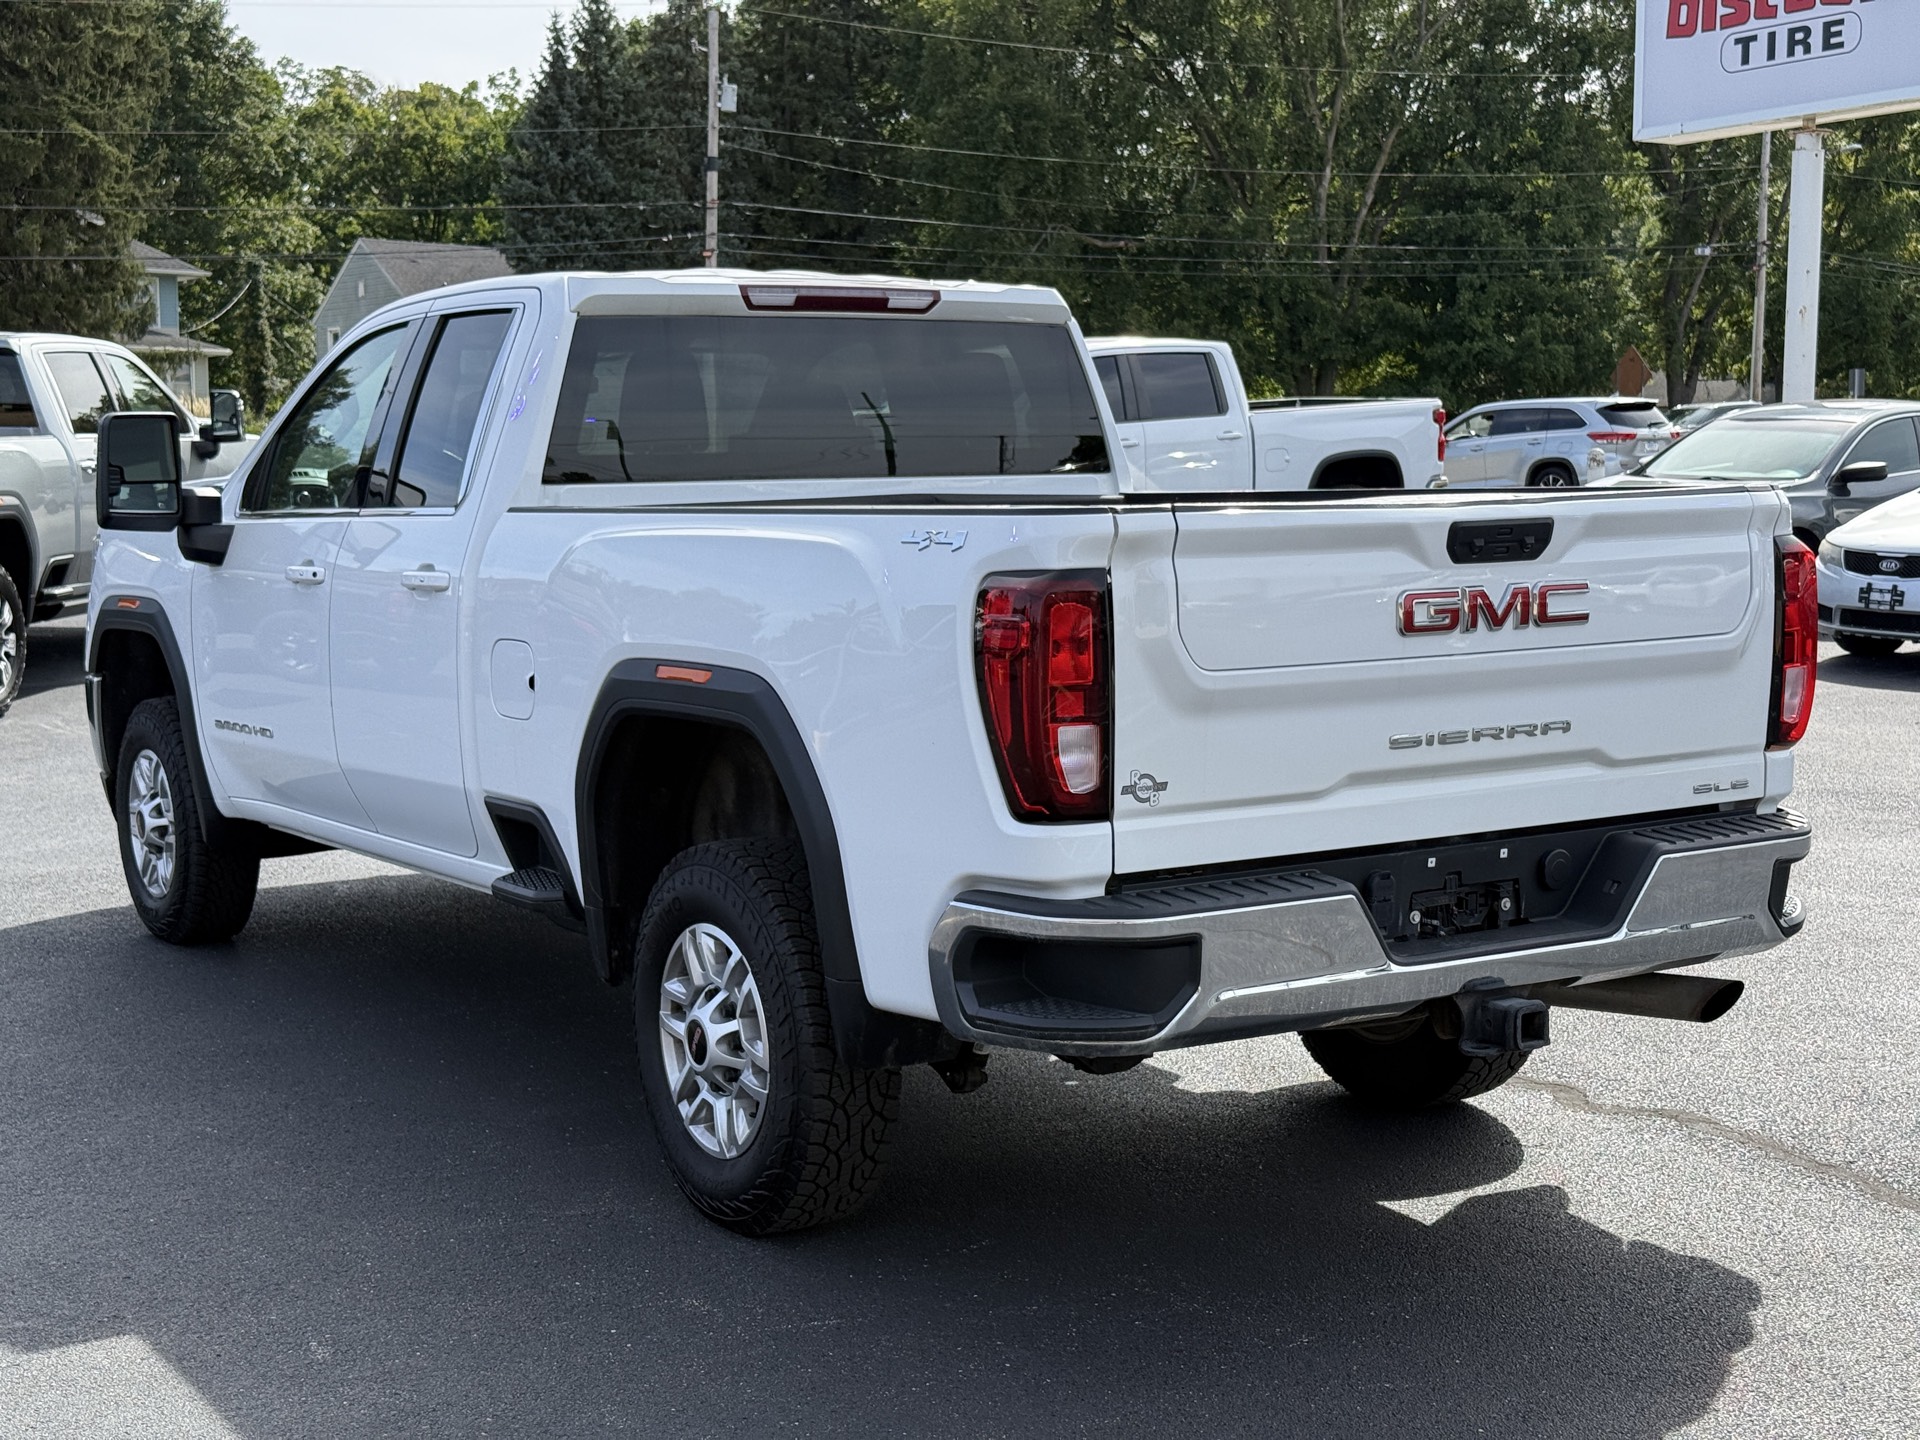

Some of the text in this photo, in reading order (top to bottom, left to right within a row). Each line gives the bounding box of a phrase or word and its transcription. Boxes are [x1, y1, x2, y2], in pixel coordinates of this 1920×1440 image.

[1734, 18, 1845, 66] TIRE
[1397, 579, 1590, 637] GMC
[1388, 719, 1572, 751] SIERRA
[1693, 779, 1750, 794] SLE
